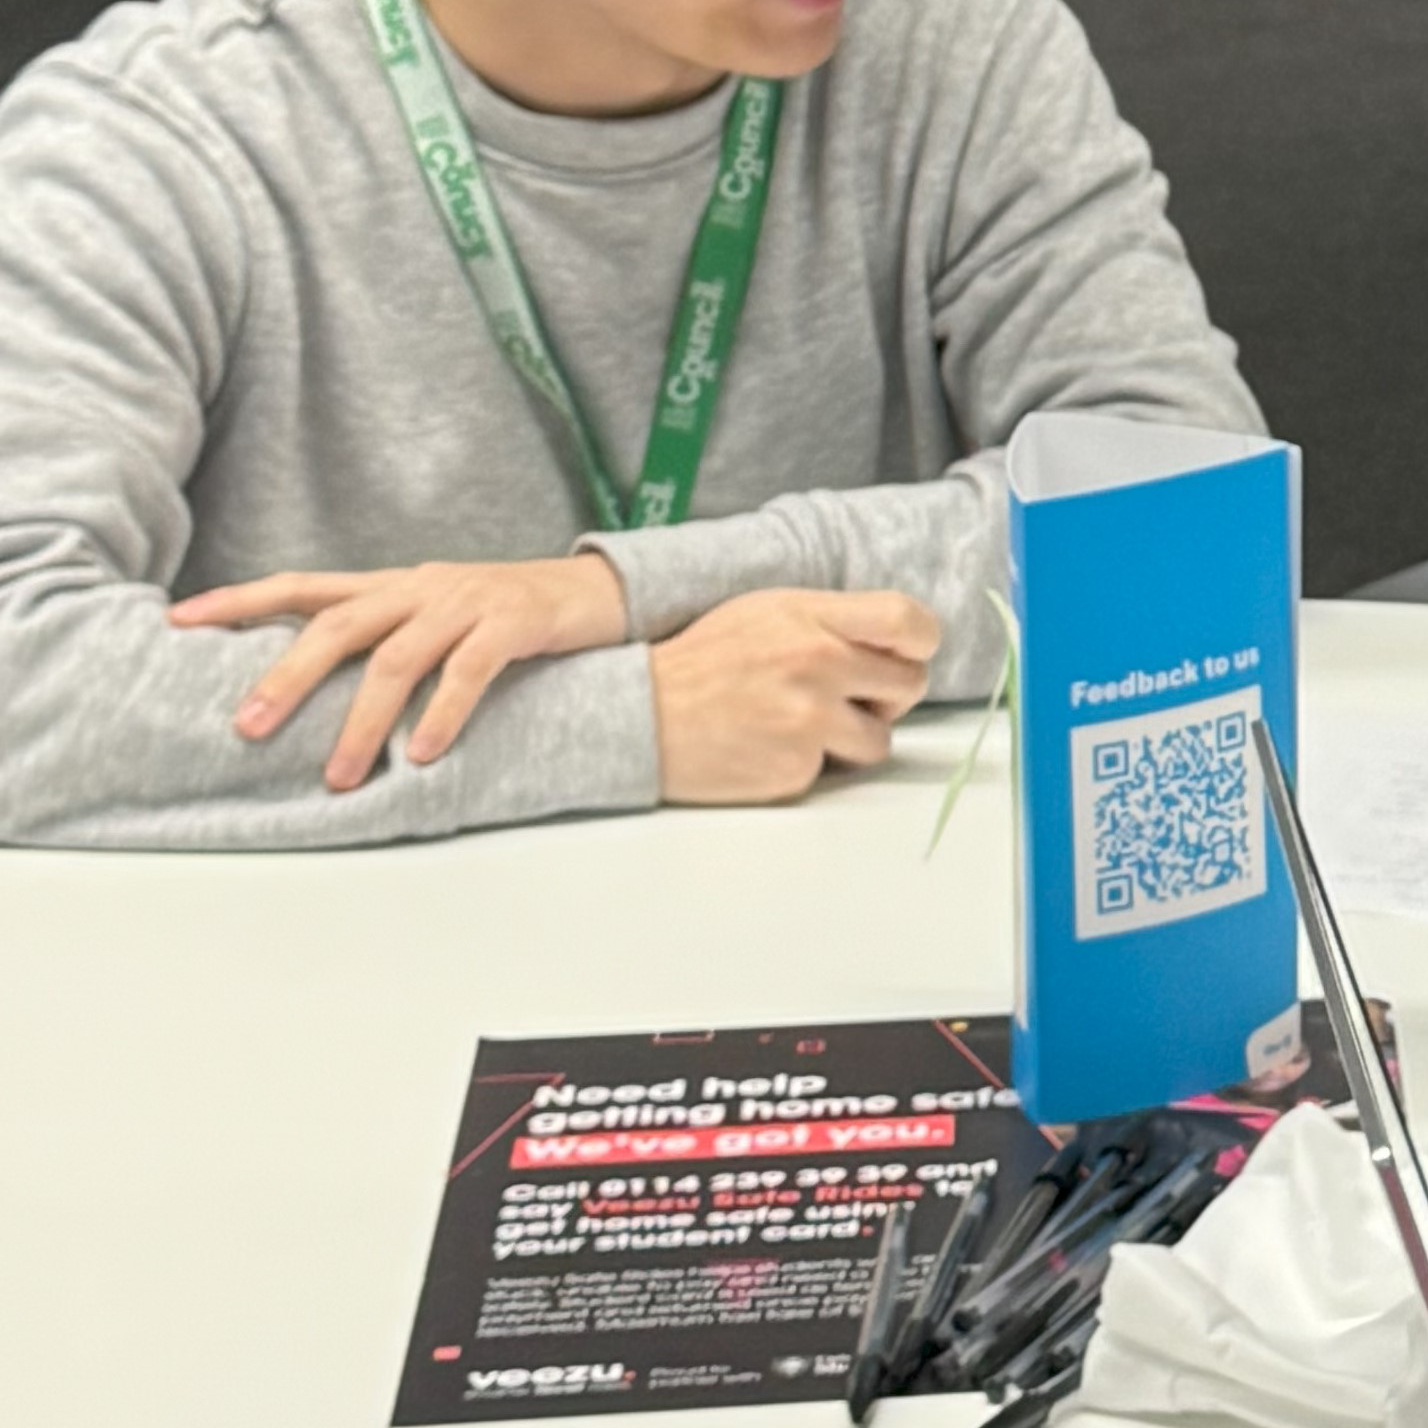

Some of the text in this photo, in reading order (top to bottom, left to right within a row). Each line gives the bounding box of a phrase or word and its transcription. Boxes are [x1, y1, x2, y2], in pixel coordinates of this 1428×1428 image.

[1069, 646, 1260, 708] Feedback to us
[533, 1073, 828, 1108] Need help
[527, 1103, 726, 1136] getting
[740, 1094, 898, 1121] home
[524, 1123, 946, 1162] We've got you.
[499, 1202, 573, 1221] say
[582, 1195, 700, 1216] Veezu
[712, 1189, 800, 1209] Safe
[814, 1183, 925, 1203] Rides
[502, 1180, 590, 1202] Call
[598, 1174, 700, 1197] 0114
[492, 1219, 874, 1261] your student card.
[495, 1218, 566, 1241] get
[575, 1212, 696, 1234] home
[706, 1206, 794, 1227] safe
